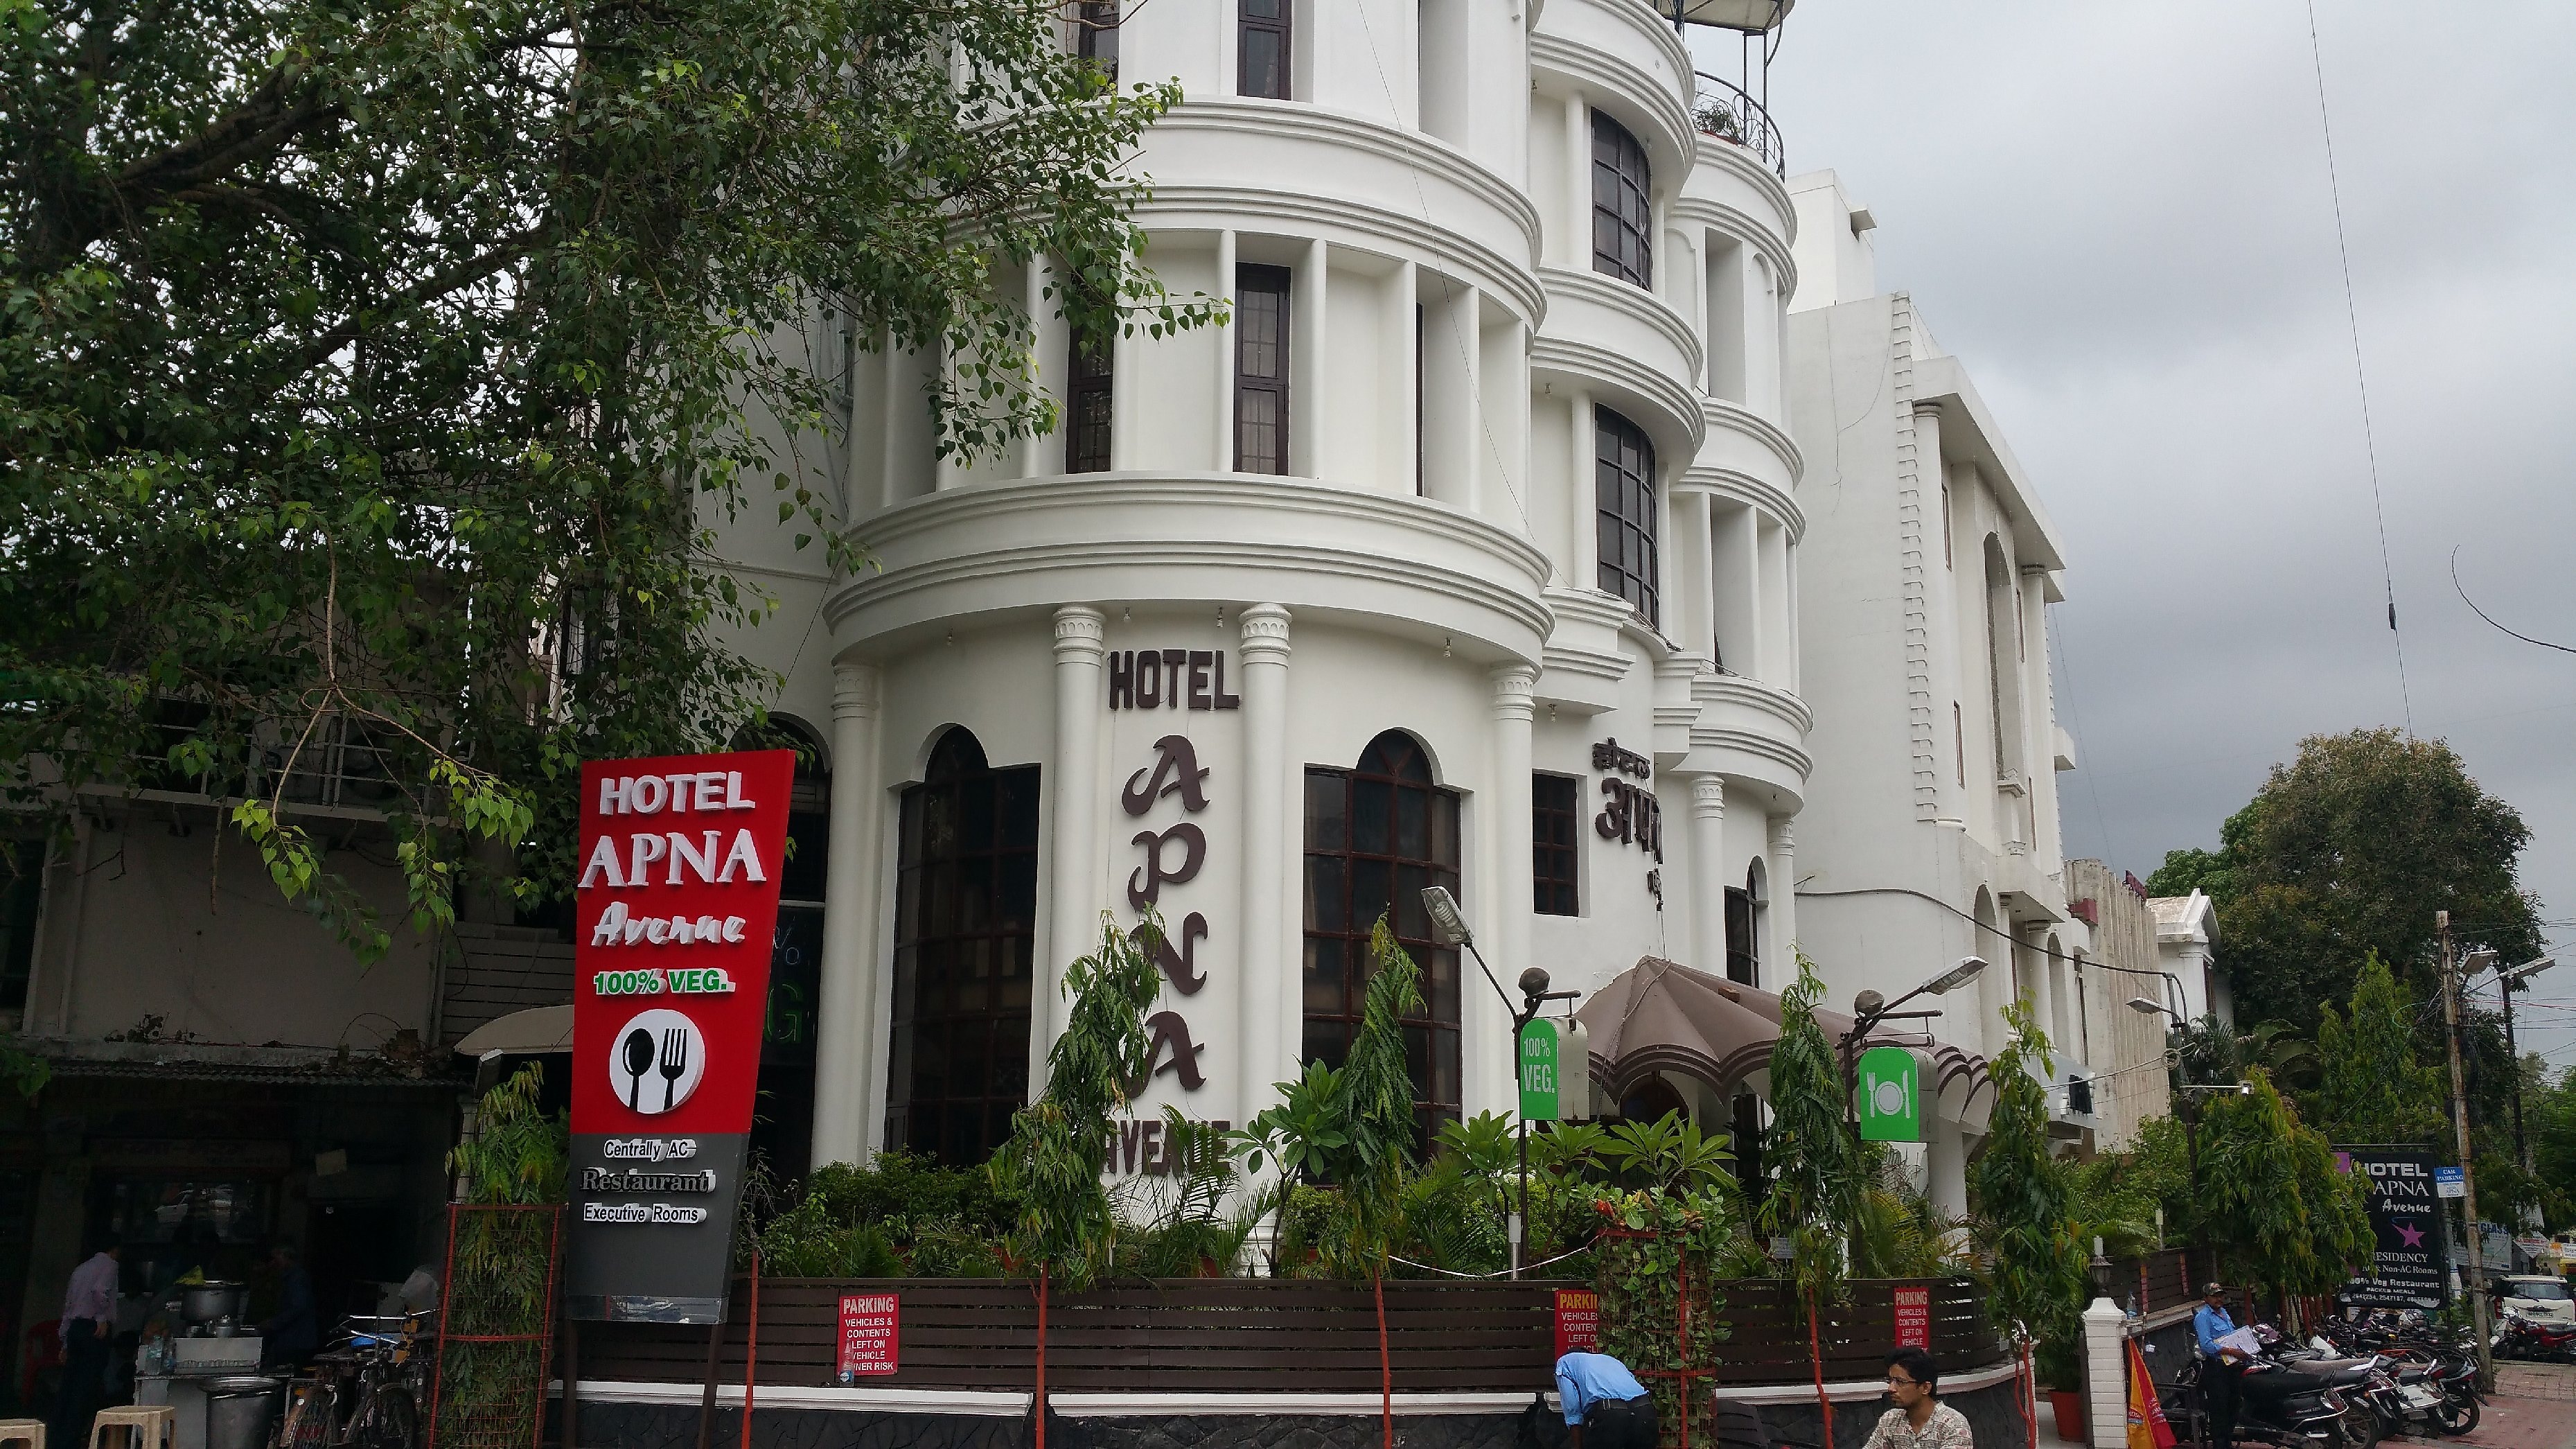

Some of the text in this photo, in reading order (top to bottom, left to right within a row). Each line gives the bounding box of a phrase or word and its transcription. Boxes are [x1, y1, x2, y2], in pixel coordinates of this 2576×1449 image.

[1109, 649, 1240, 710] HOTEL
[599, 771, 756, 816] HOTEL
[577, 828, 767, 888] APNA
[1121, 734, 1211, 1098] APNA
[591, 902, 746, 947] Avenue
[593, 969, 732, 994] 100% VEG.
[1524, 1037, 1551, 1057] 100%
[1524, 1064, 1555, 1094] VEG.
[604, 1141, 689, 1161] Centrally AC
[580, 1168, 711, 1193] Restaurant
[2373, 1180, 2430, 1197] APNA
[584, 1204, 698, 1222] Executive Rooms
[2382, 1198, 2431, 1213] Avenue
[2382, 1265, 2412, 1274] Non-AC
[2413, 1265, 2438, 1275] Rooms
[2372, 1277, 2388, 1287] Veg
[2390, 1279, 2440, 1289] Restaurant
[843, 1297, 894, 1315] PARKING
[1896, 1291, 1927, 1306] PARKING
[845, 1317, 893, 1327] VEHICLES &
[1563, 1323, 1598, 1332] CONTEN
[1898, 1318, 1926, 1326] CONTENTS
[847, 1328, 891, 1338] CONTENTS
[1568, 1334, 1588, 1343] LEFT
[1902, 1328, 1923, 1337] LEFT ON
[852, 1340, 885, 1349] LEFT ON
[1902, 1337, 1923, 1346] VEHICLE
[854, 1361, 894, 1371] NER RISK
